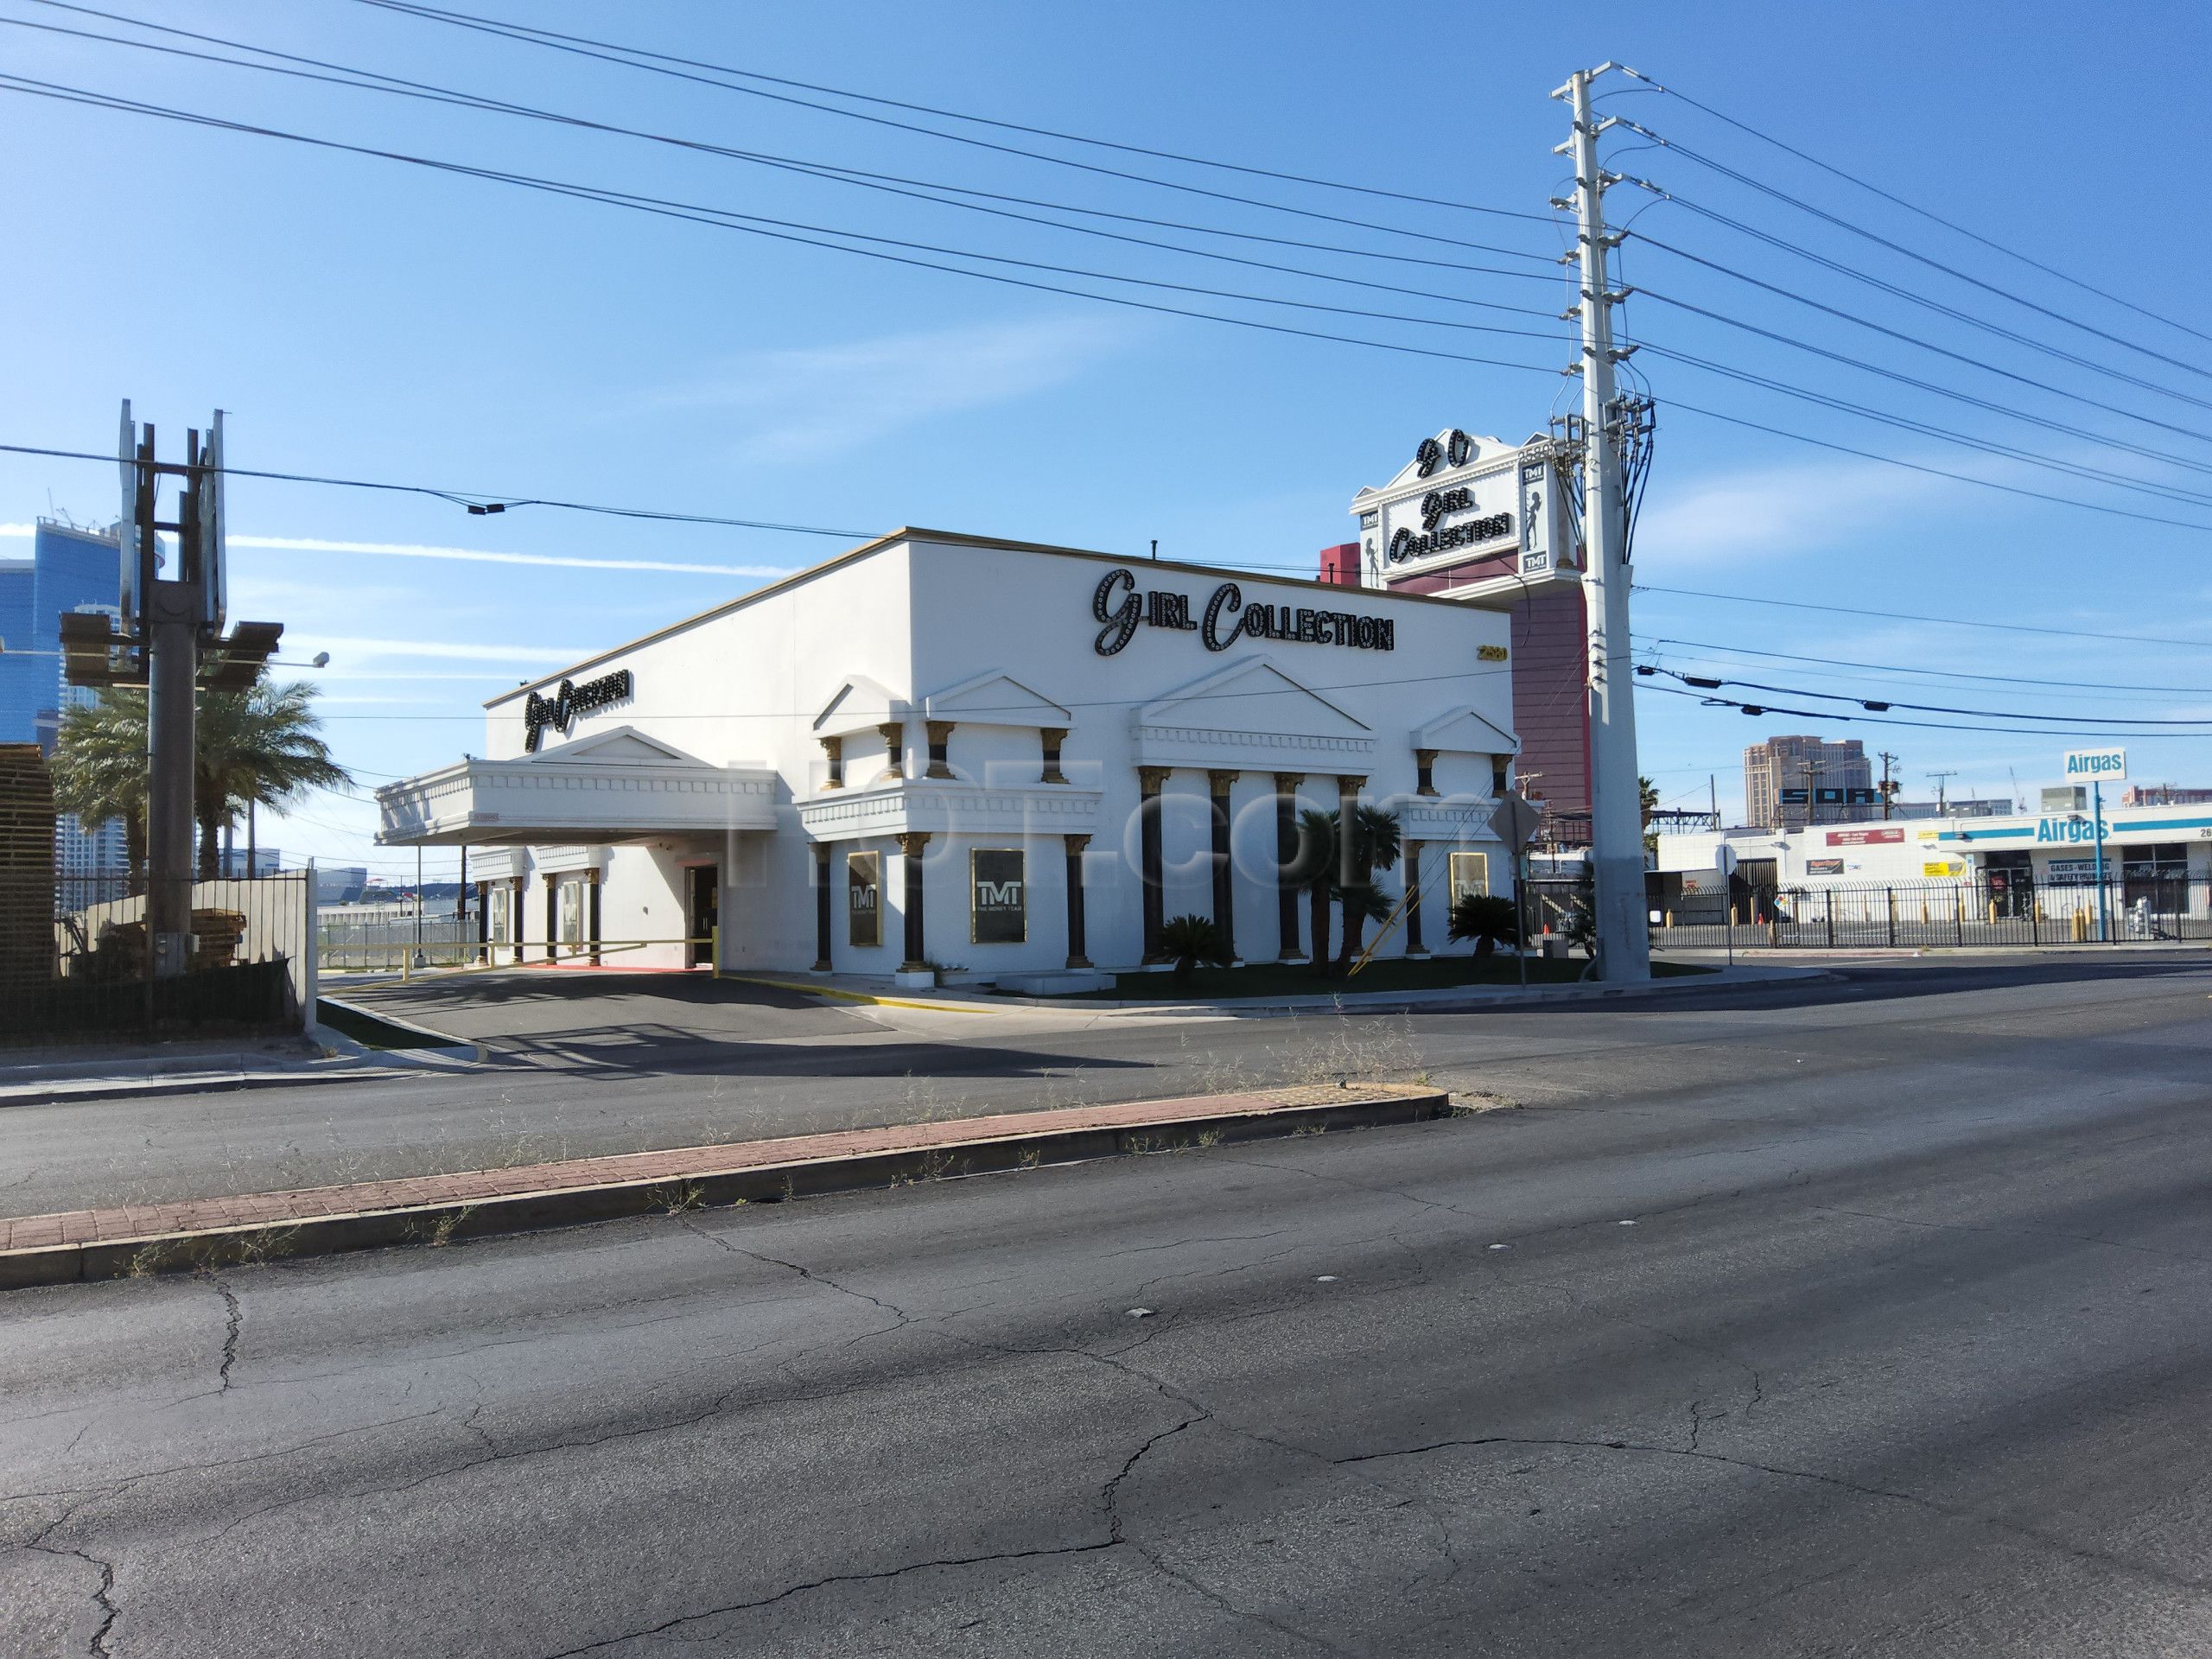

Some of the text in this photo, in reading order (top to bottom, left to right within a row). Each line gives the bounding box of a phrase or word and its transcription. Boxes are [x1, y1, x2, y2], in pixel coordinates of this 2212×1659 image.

[1421, 486, 1473, 531] GIRL
[1389, 512, 1510, 563] COLLECTION
[1092, 569, 1395, 657] GIRL COLLECTION
[524, 669, 630, 753] GIRL COLLECTION
[2067, 753, 2122, 773] Airgas
[2037, 817, 2109, 843] Airgas
[2200, 828, 2212, 837] 26
[976, 881, 1022, 905] TMT
